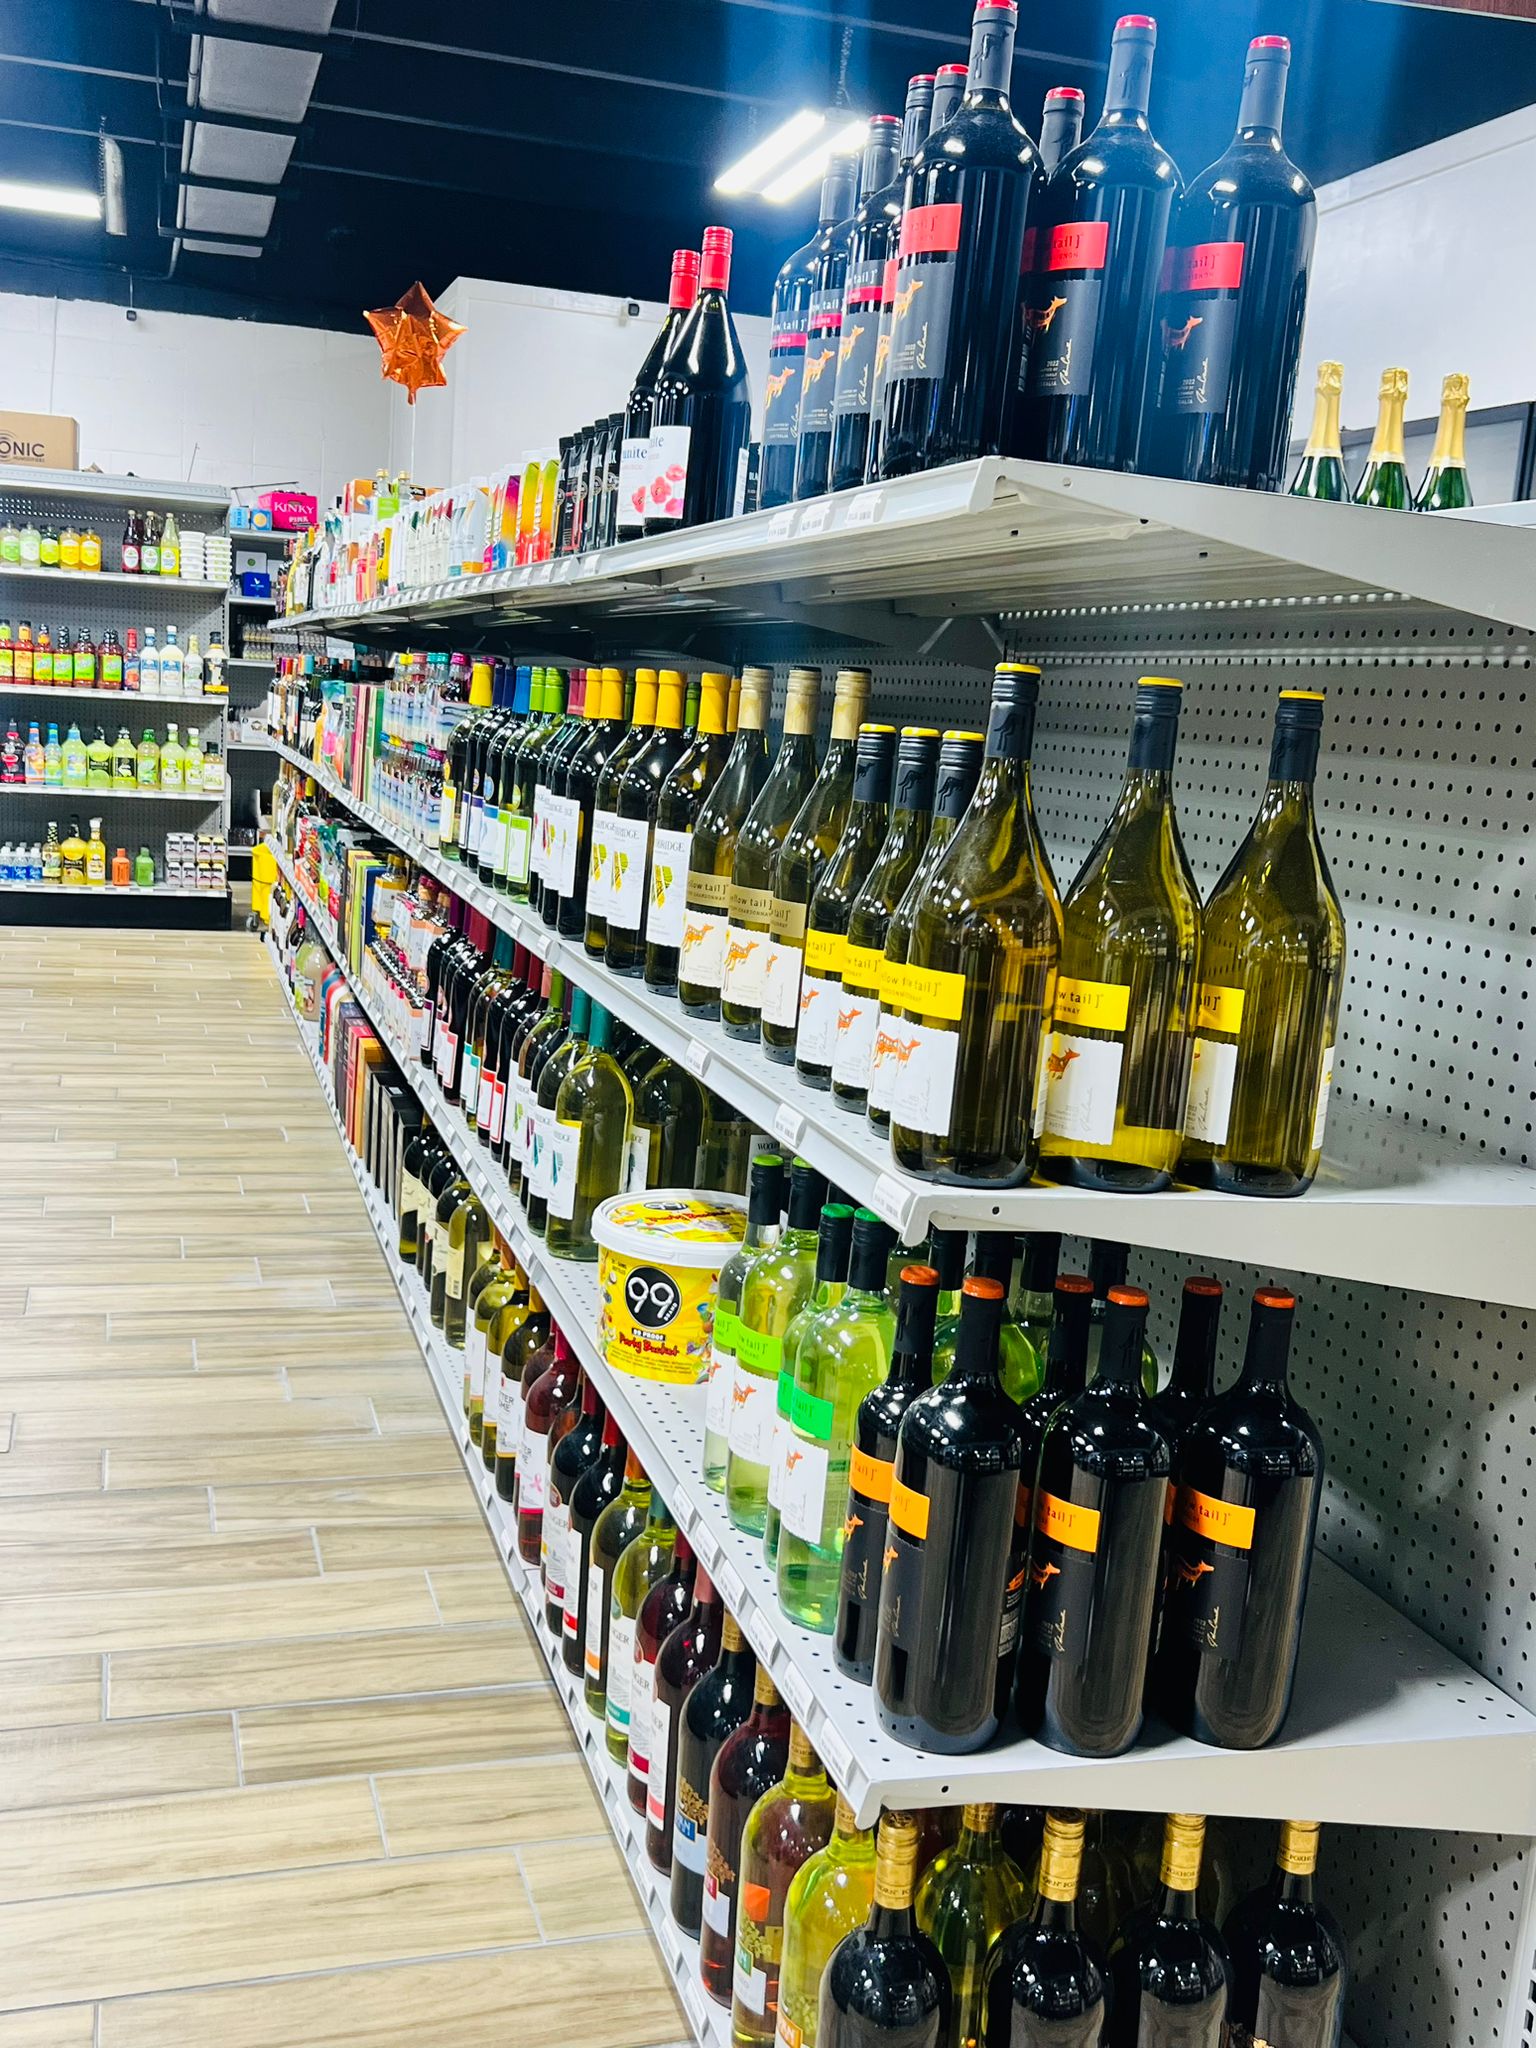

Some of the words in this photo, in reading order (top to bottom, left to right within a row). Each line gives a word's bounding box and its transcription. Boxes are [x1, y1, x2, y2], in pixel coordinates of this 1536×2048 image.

[274, 501, 315, 515] KINKY
[628, 1276, 675, 1319] 99
[619, 1331, 642, 1354] Party
